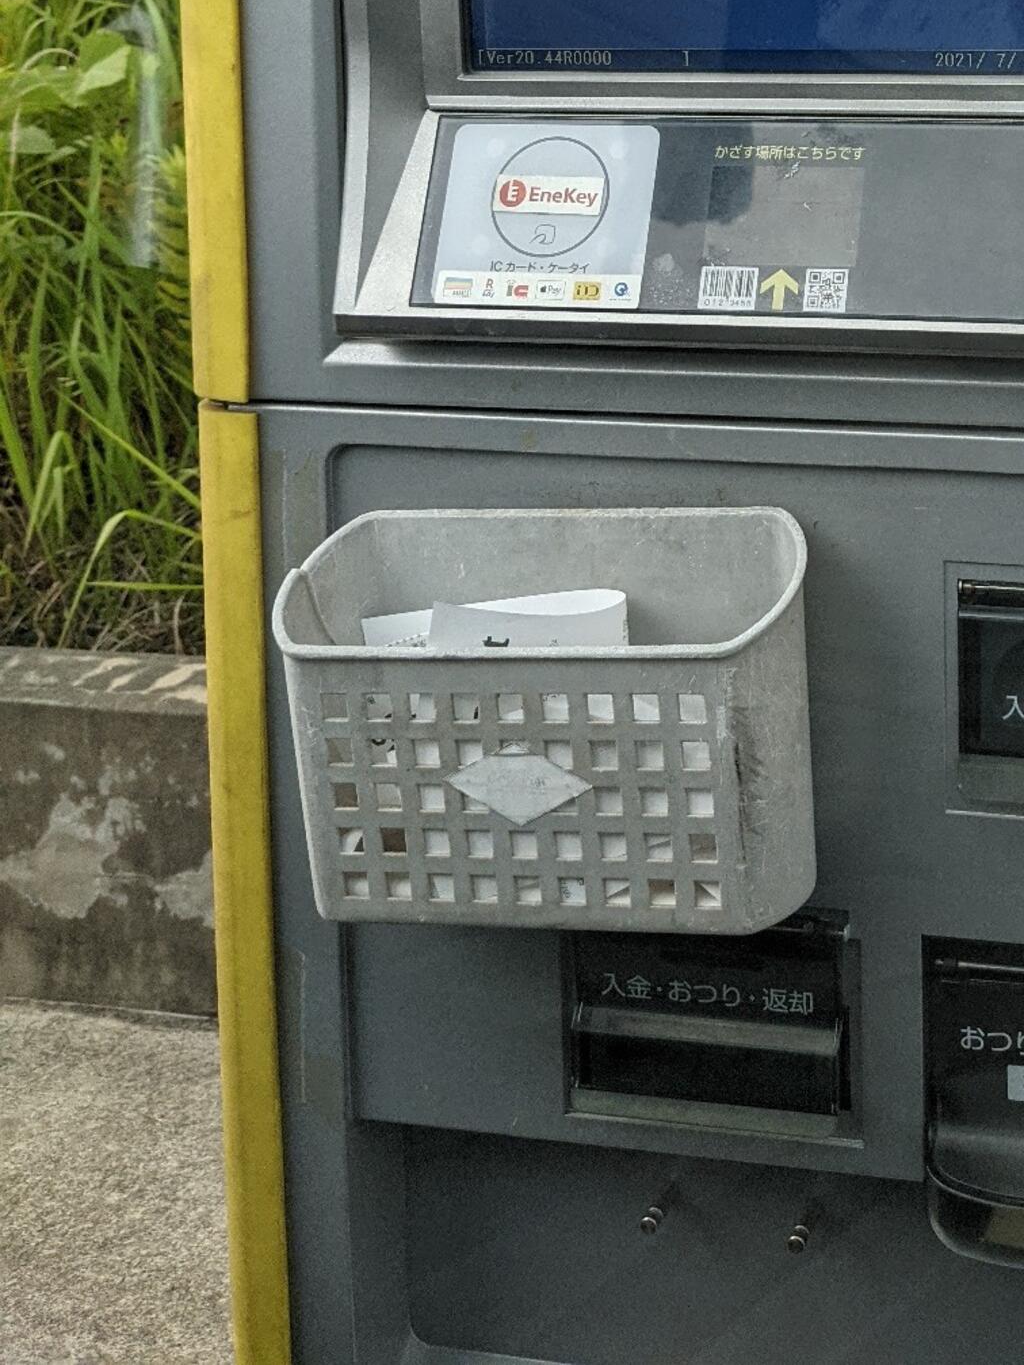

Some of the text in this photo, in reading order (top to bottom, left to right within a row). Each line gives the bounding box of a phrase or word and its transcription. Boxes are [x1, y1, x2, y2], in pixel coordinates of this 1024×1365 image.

[714, 145, 866, 160] かざす場所はこちらです
[529, 187, 599, 208] EneKey
[601, 972, 814, 1015] 入金・おつり・返却
